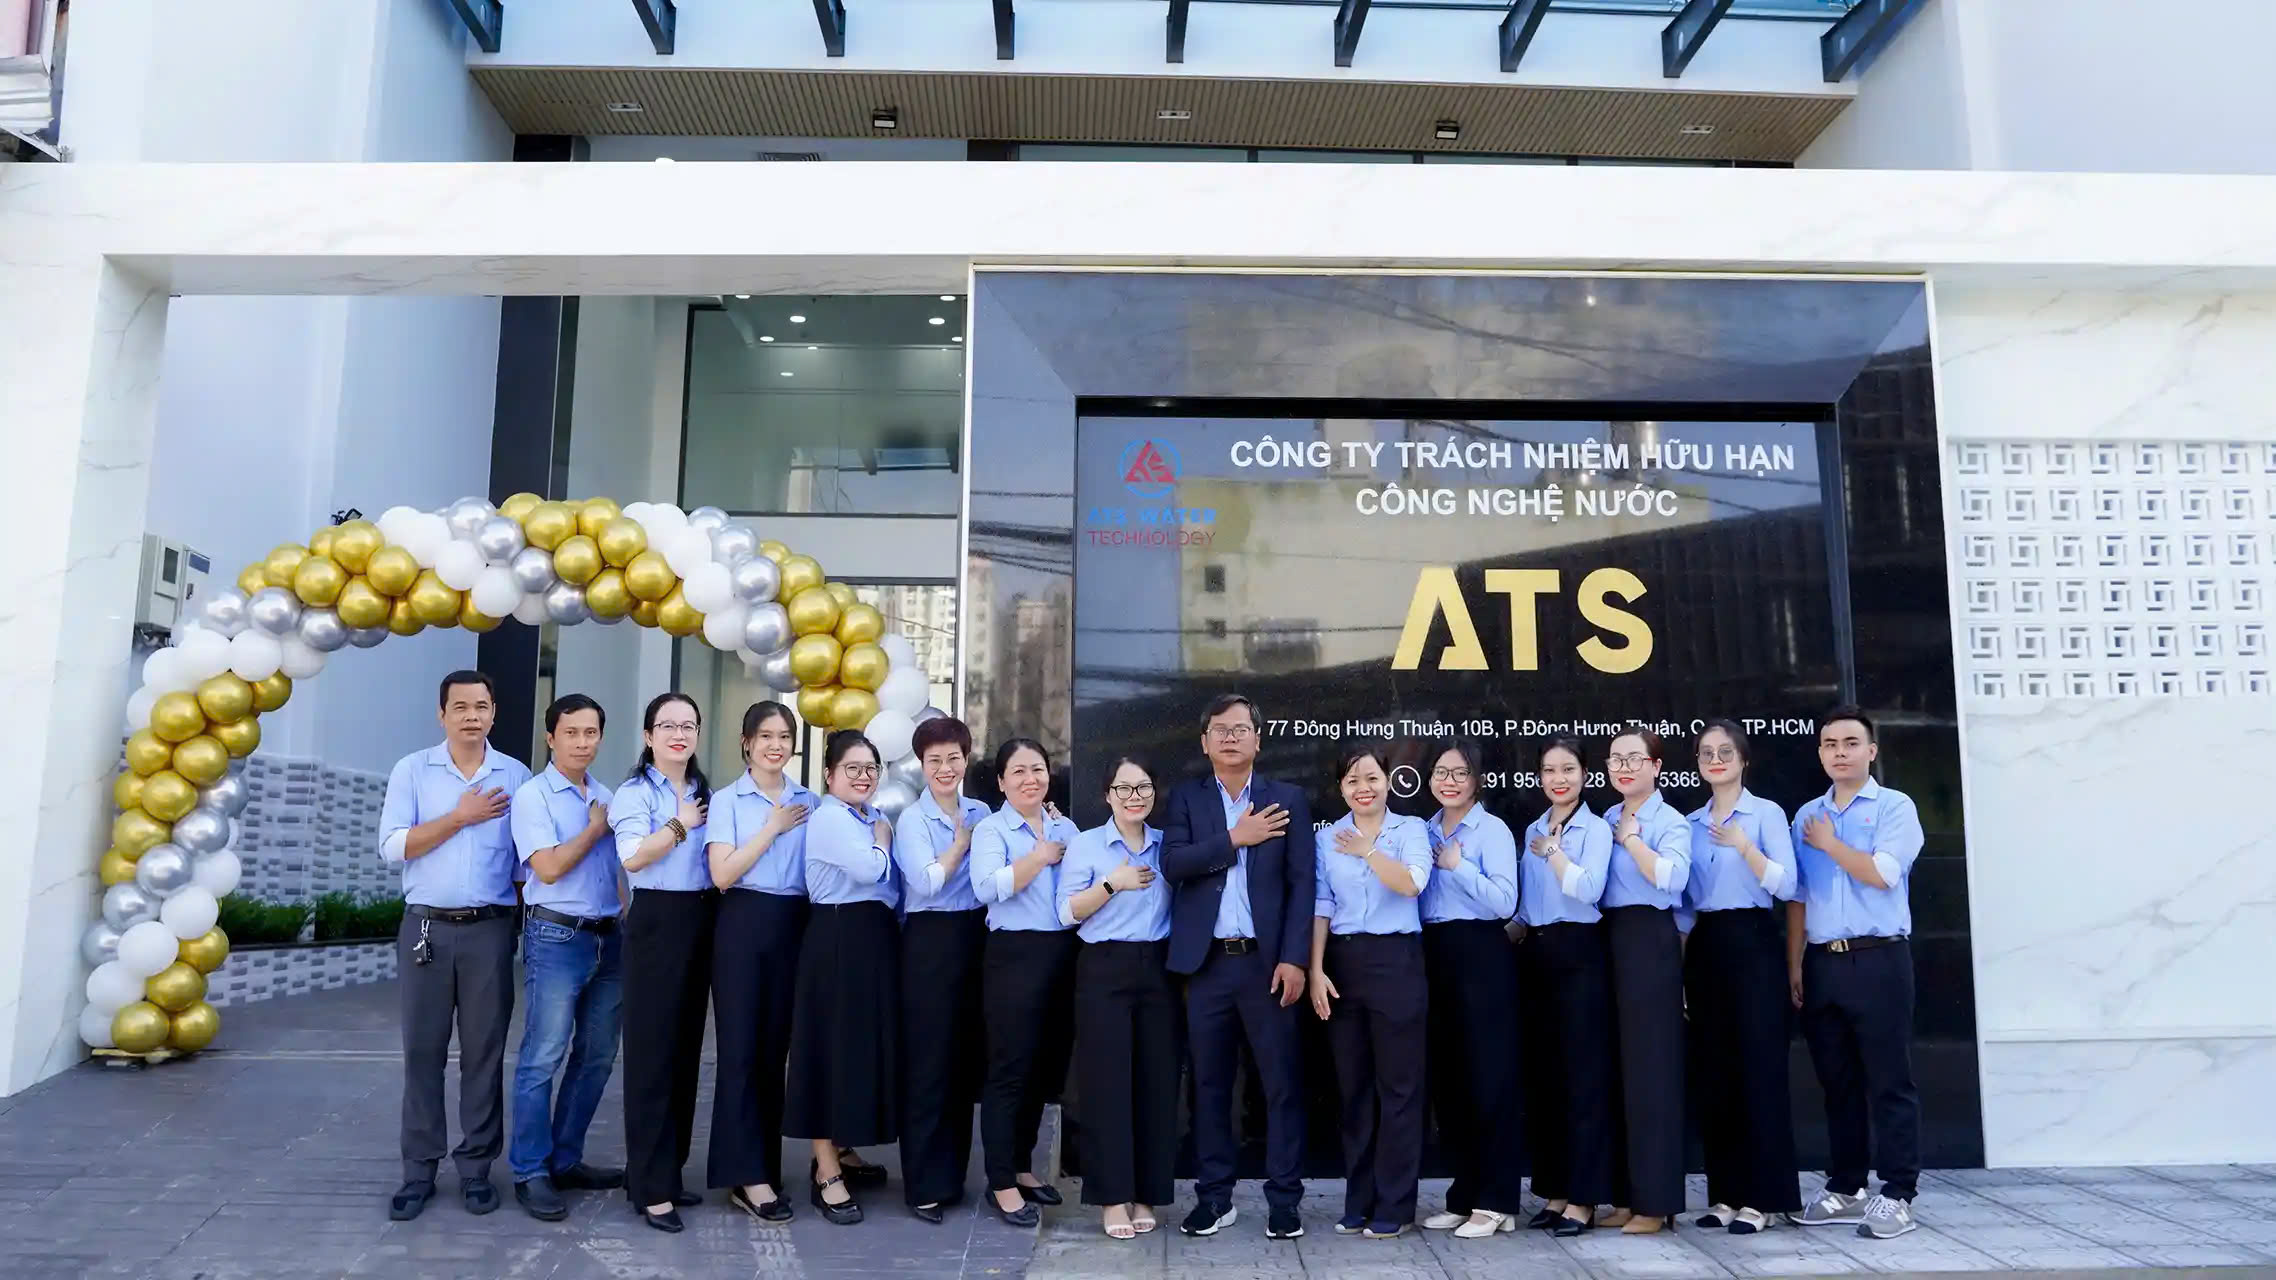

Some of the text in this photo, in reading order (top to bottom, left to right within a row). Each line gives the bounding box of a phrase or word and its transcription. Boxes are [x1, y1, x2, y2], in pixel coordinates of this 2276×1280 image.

[1230, 434, 1795, 477] CÔNG TY TRÁCH NHIỆM HỮU HẠN
[1356, 482, 1678, 522] CÔNG NGHỆ NƯỚC
[1088, 530, 1217, 546] TECHNOLOGY
[1391, 567, 1654, 673] ATS
[1267, 719, 1289, 736] 77
[1293, 719, 1341, 740] Đông
[1346, 720, 1394, 740] Hưng
[1399, 719, 1454, 740] Thuận
[1460, 720, 1499, 739] 10B,
[1741, 718, 1814, 736] TP.HCM
